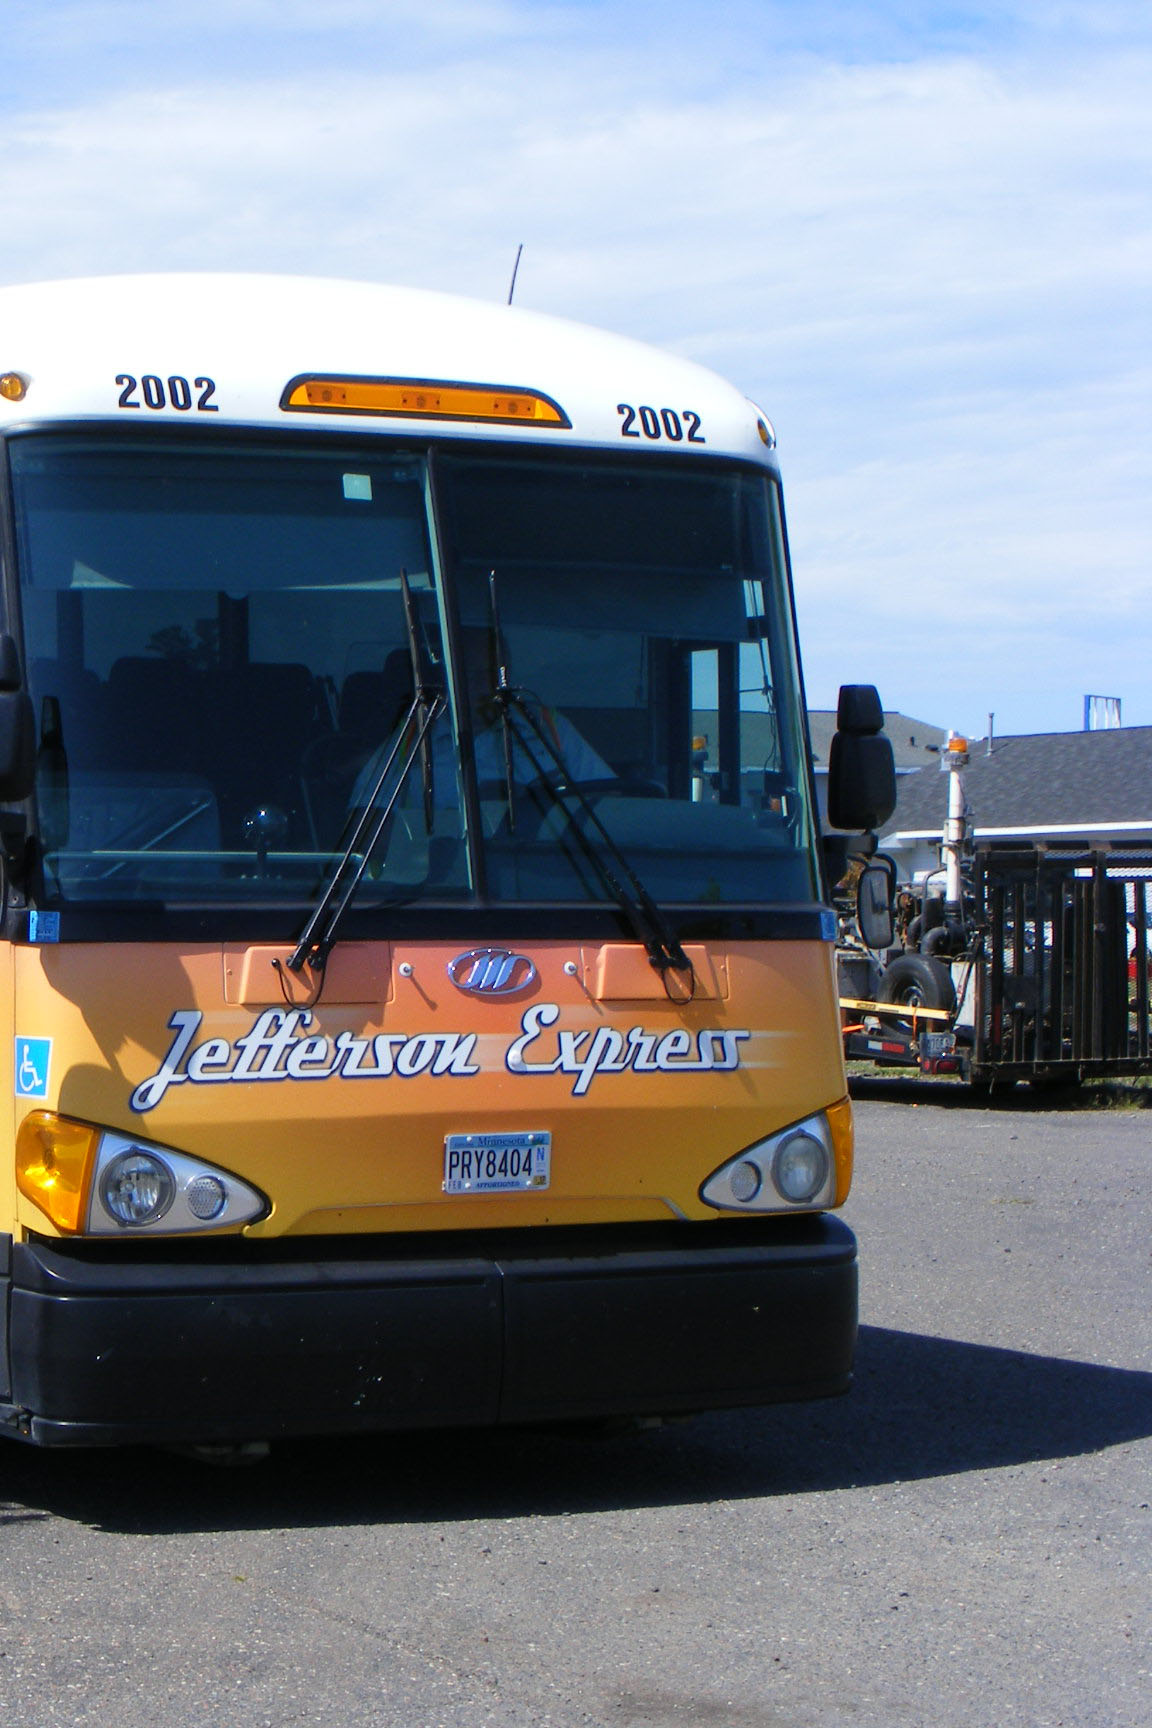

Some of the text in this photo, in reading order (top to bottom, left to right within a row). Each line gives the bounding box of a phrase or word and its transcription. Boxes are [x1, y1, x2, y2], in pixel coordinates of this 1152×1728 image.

[115, 374, 219, 412] 2002
[616, 403, 706, 443] 2002
[130, 1002, 752, 1114] Jefferson Express
[479, 1137, 526, 1146] Minnesota
[449, 1148, 533, 1179] PRY8404
